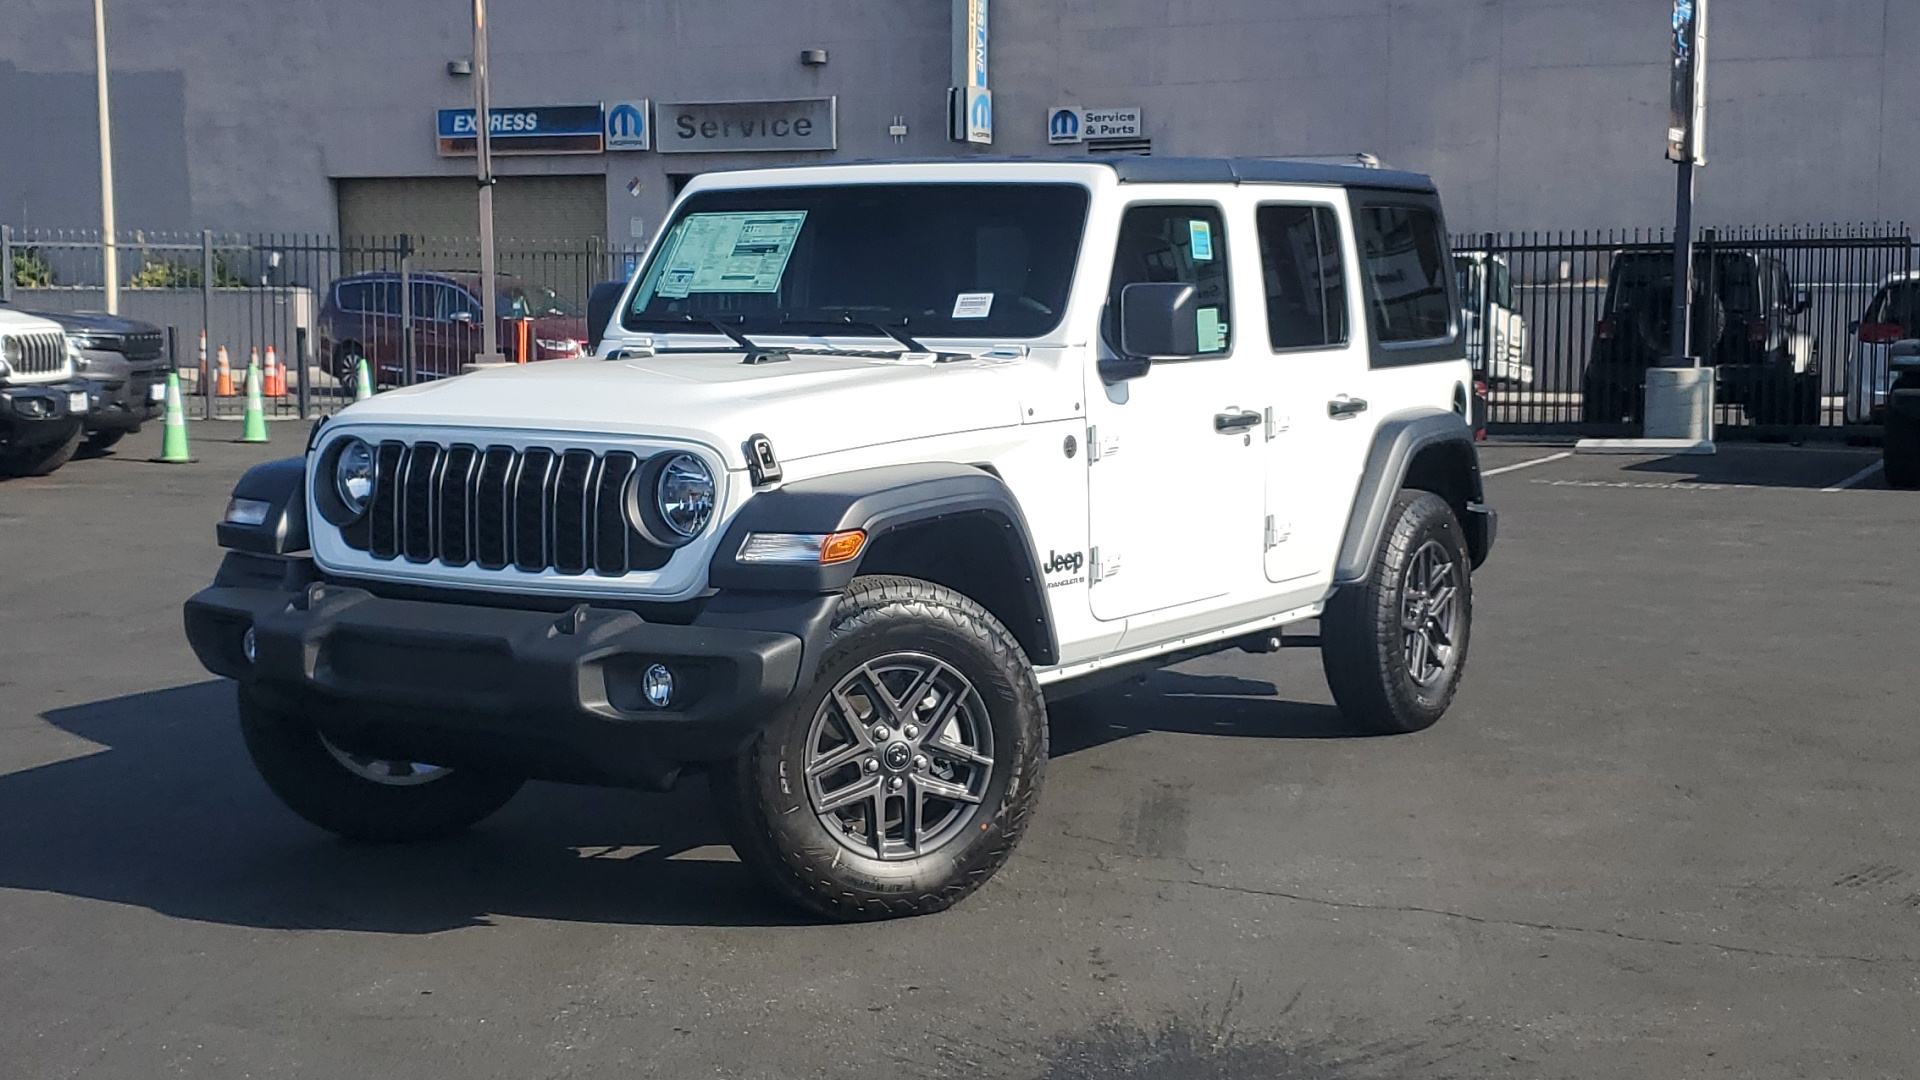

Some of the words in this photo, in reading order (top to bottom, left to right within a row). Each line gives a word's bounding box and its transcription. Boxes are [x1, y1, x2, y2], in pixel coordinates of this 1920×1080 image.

[976, 0, 985, 73] SSLANE
[454, 112, 538, 132] EXRESS
[676, 114, 813, 139] Service
[1085, 112, 1135, 122] Service
[1085, 125, 1095, 135] &
[1100, 125, 1134, 135] Parts
[1043, 550, 1084, 574] Jeep
